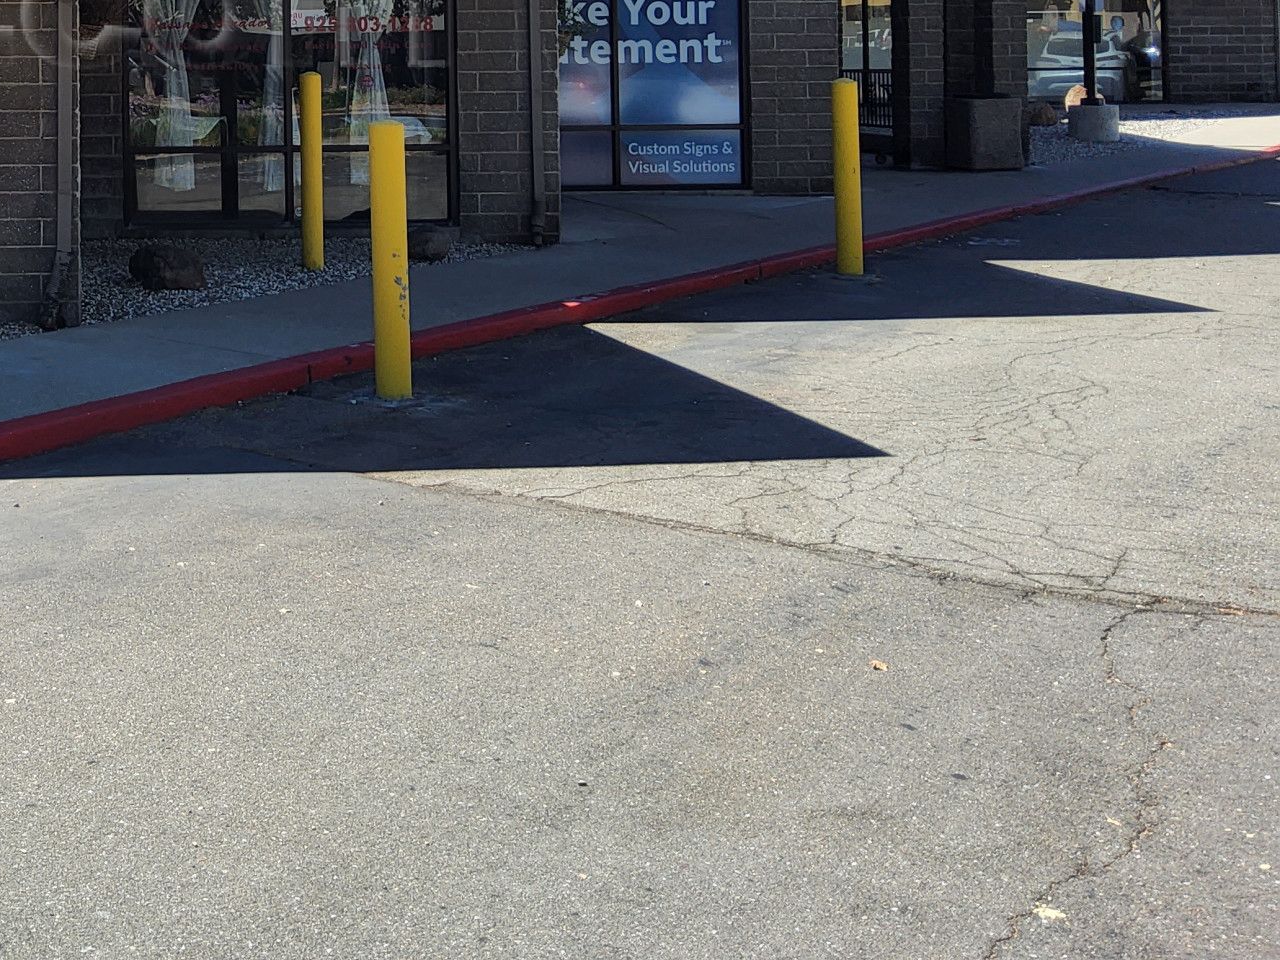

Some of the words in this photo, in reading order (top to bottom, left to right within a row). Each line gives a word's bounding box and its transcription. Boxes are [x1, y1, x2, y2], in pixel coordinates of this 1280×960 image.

[628, 142, 680, 156] Custom
[683, 142, 719, 157] Signs
[722, 142, 733, 154] &
[628, 160, 669, 173] Visual
[673, 160, 736, 173] Solutions
